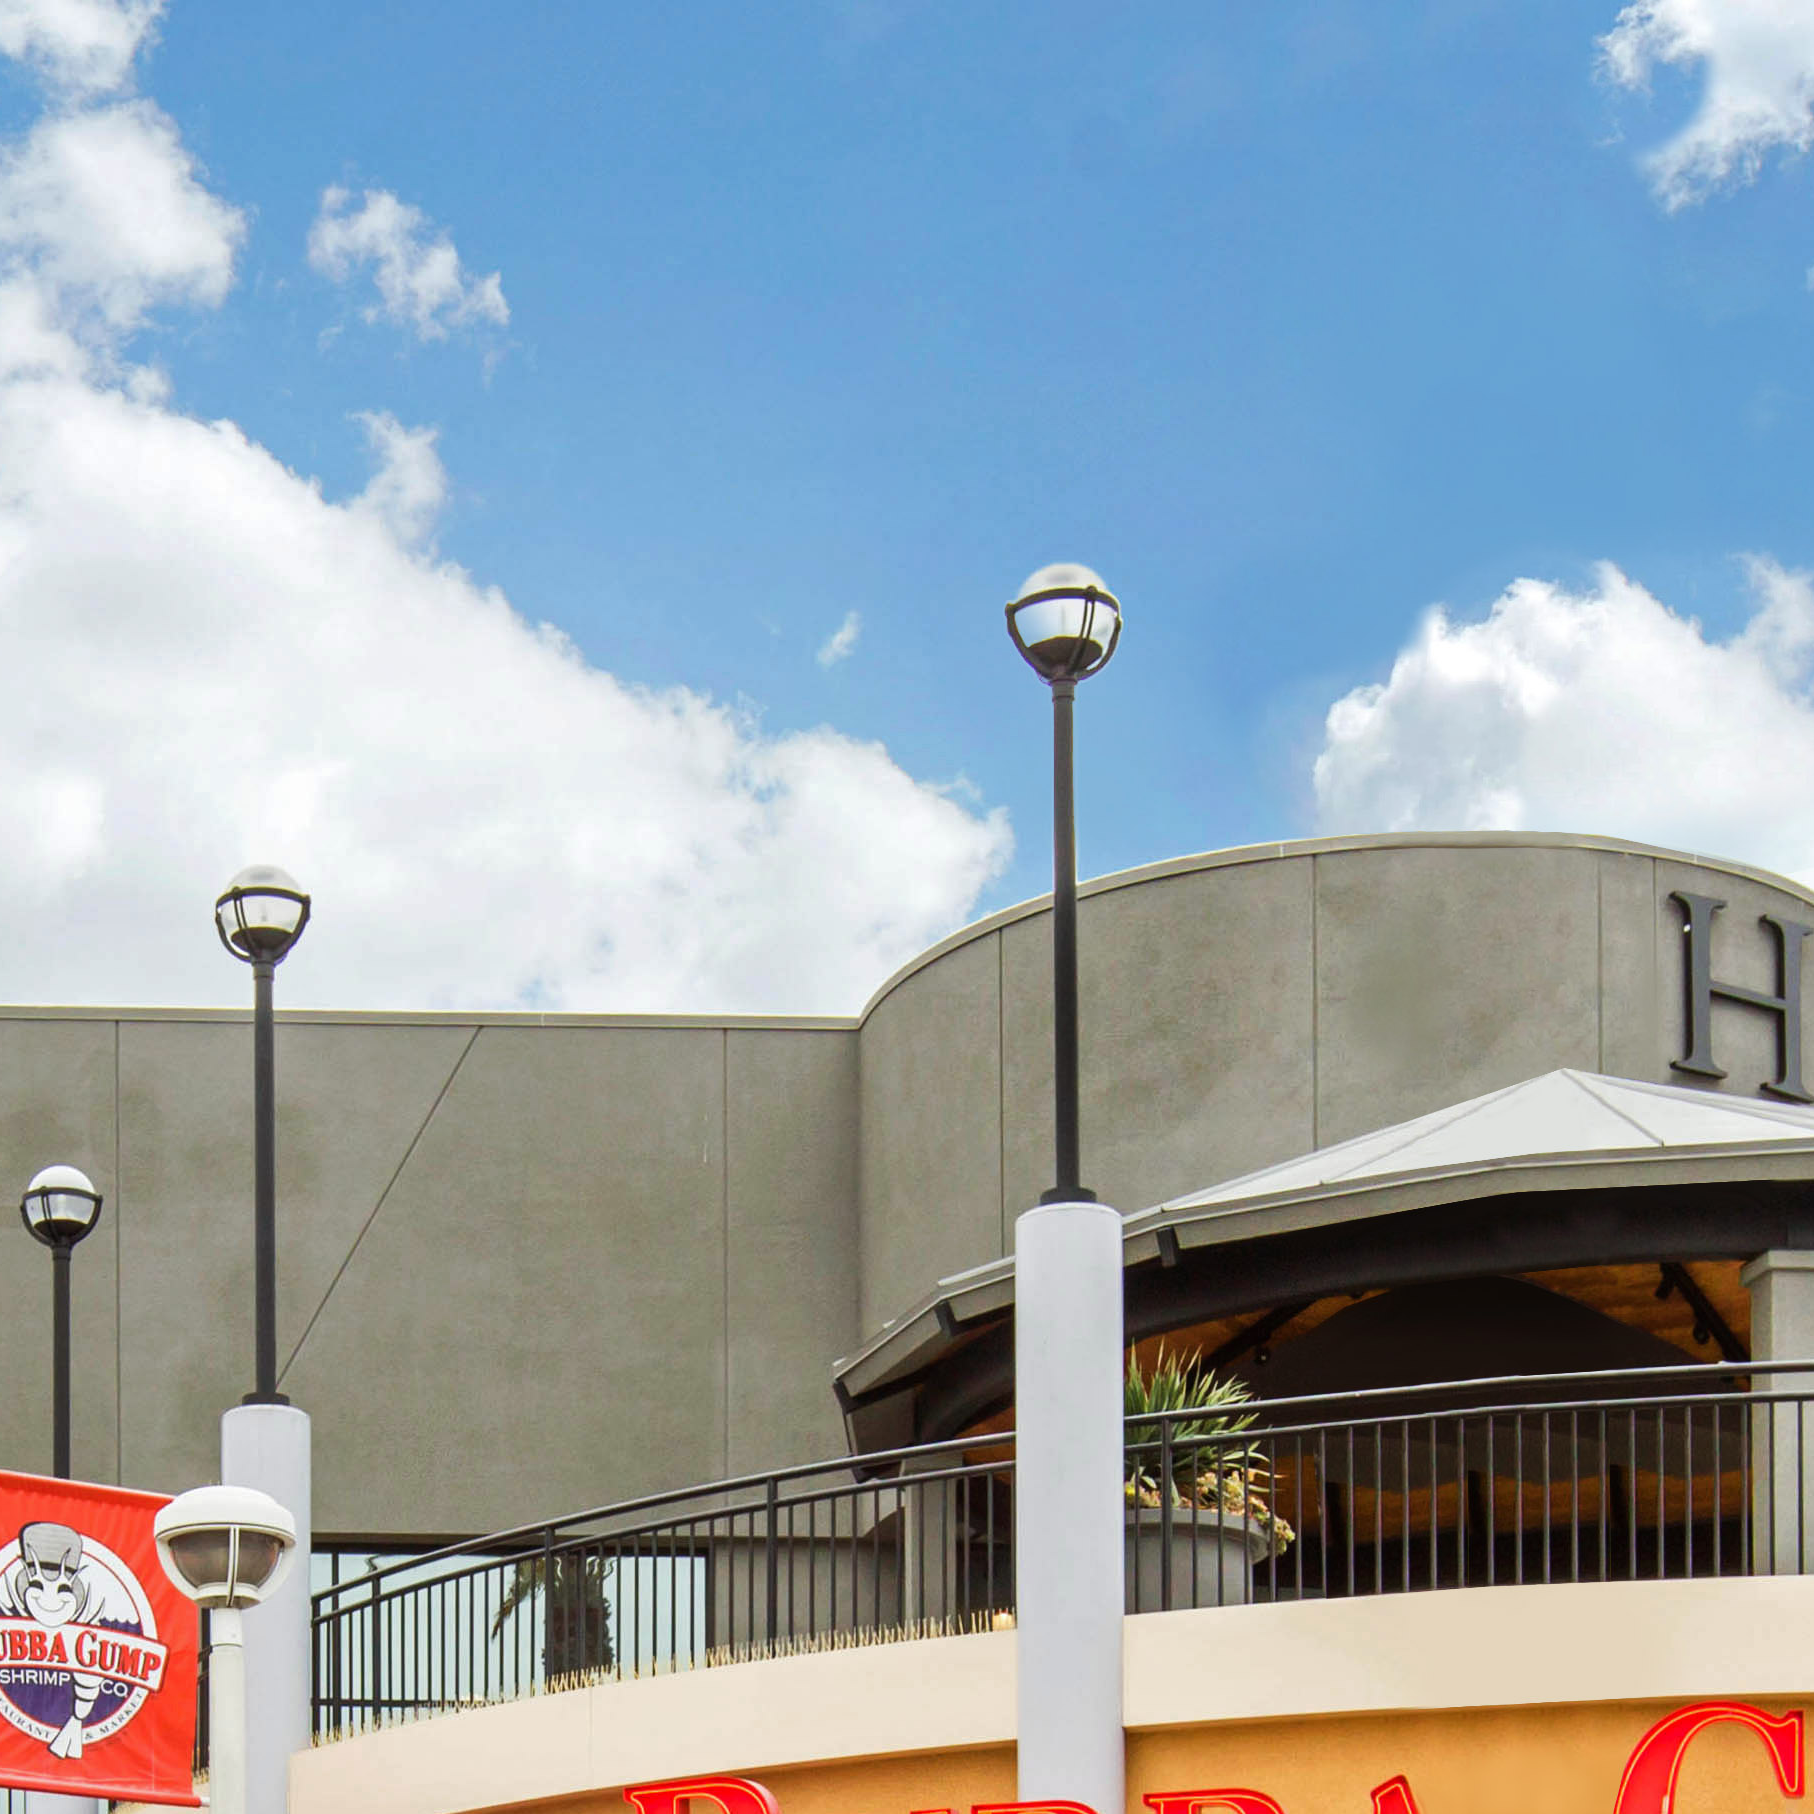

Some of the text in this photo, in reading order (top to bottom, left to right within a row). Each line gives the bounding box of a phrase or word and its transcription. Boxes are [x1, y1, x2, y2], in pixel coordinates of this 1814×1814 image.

[74, 1630, 162, 1681] GUMP
[0, 1669, 71, 1687] SHRIMP
[98, 1693, 143, 1734] MARKET
